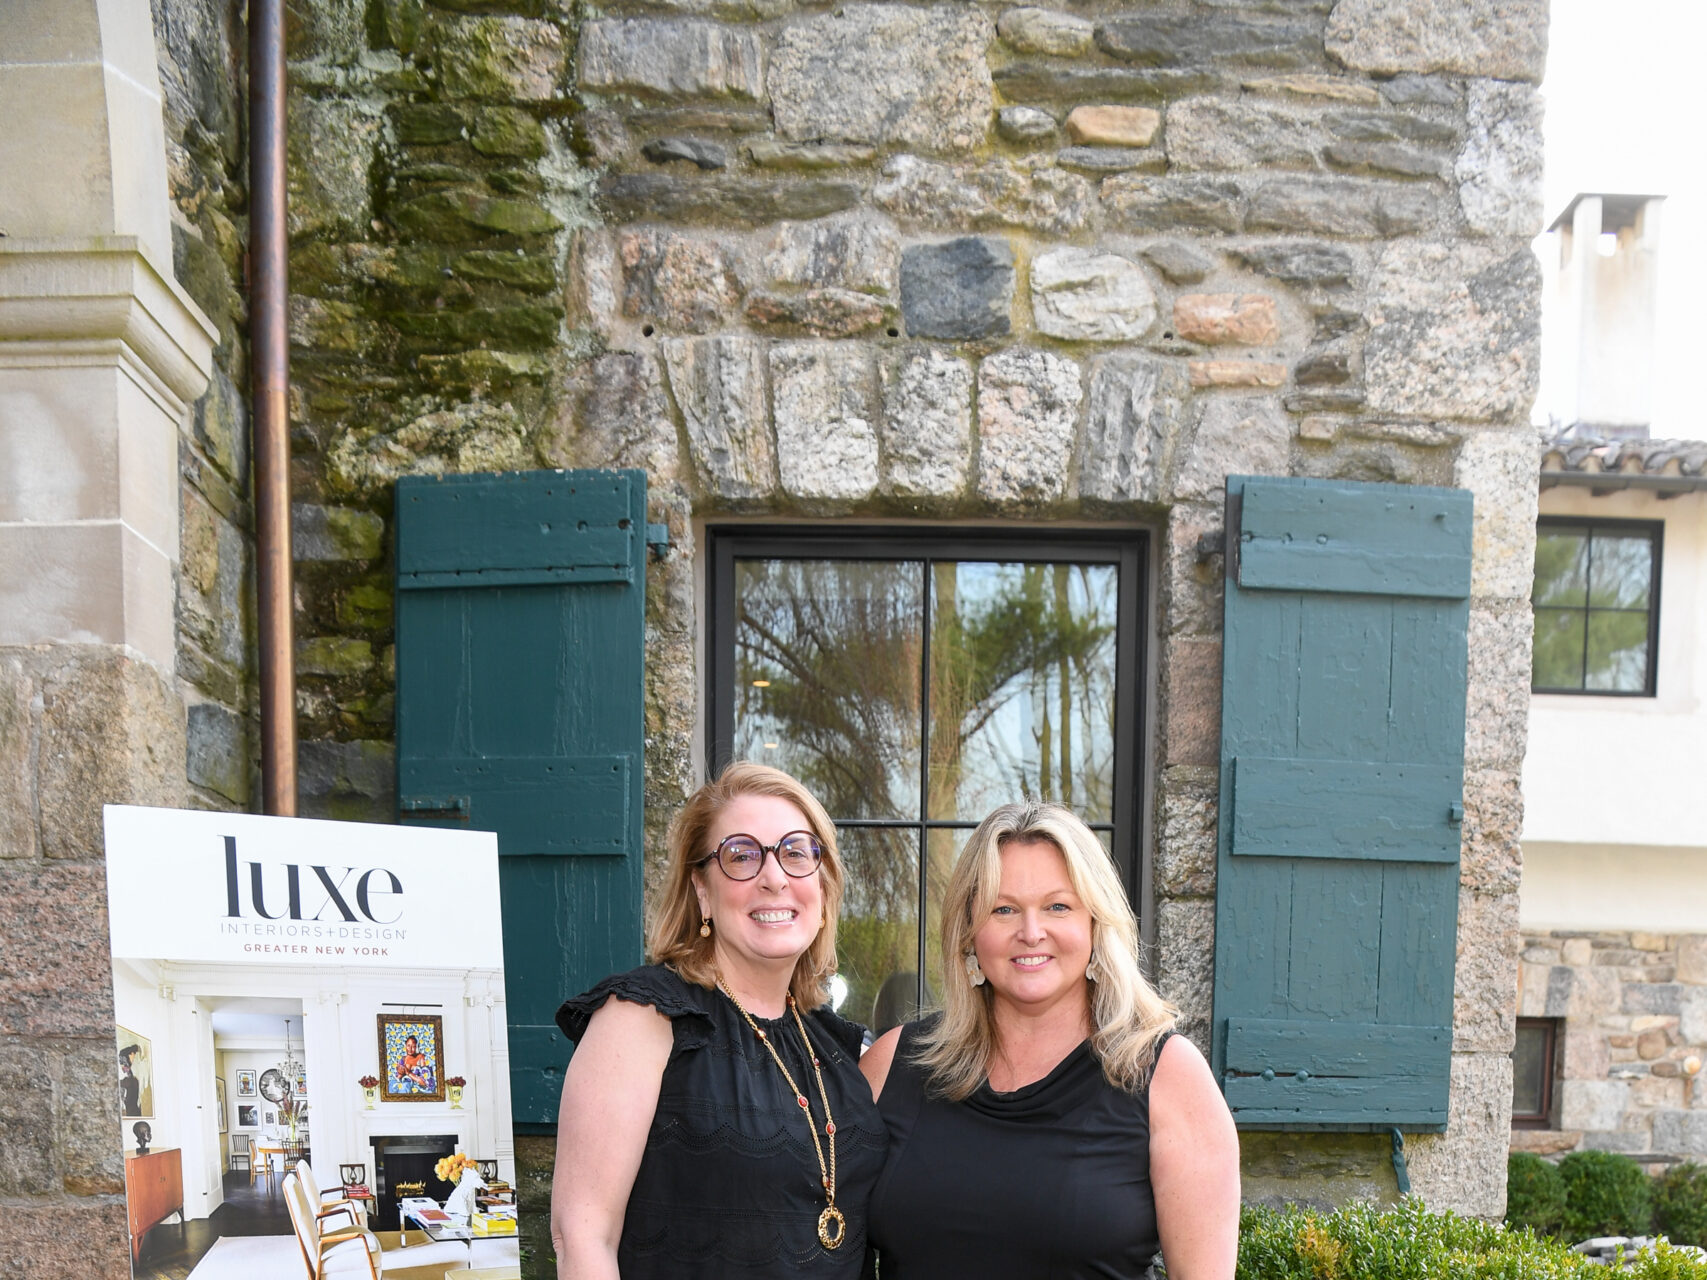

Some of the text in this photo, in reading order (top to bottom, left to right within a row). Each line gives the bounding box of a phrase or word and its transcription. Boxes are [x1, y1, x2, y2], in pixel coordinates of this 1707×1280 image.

[217, 835, 403, 925] luxe
[244, 943, 389, 957] GREATER NEW YORK
